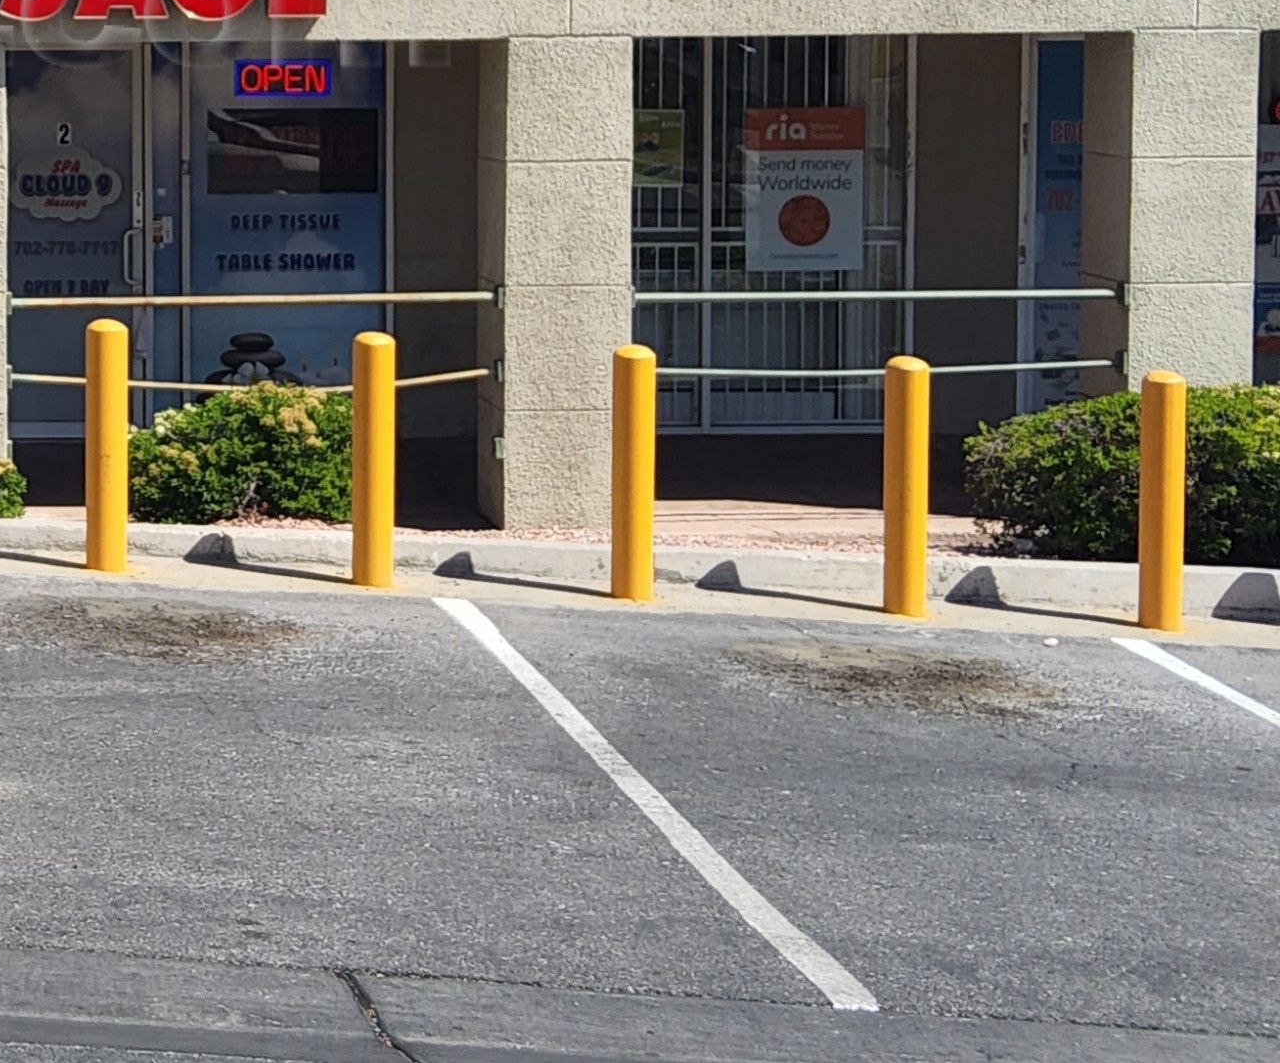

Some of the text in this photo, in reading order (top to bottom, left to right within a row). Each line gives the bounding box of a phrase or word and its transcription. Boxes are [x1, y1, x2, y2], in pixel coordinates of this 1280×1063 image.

[241, 64, 325, 93] OPEN
[59, 123, 70, 145] 2
[765, 113, 807, 141] ria
[52, 159, 81, 174] SPA
[758, 158, 853, 173] Send money
[20, 173, 113, 197] CLOUD 9
[758, 175, 853, 191] Worldwide
[44, 198, 88, 210] Massage
[231, 214, 341, 231] DEEP TISSUE
[215, 252, 356, 273] TABLE SHOWER
[24, 279, 62, 294] OPEN
[81, 278, 110, 294] DAY
